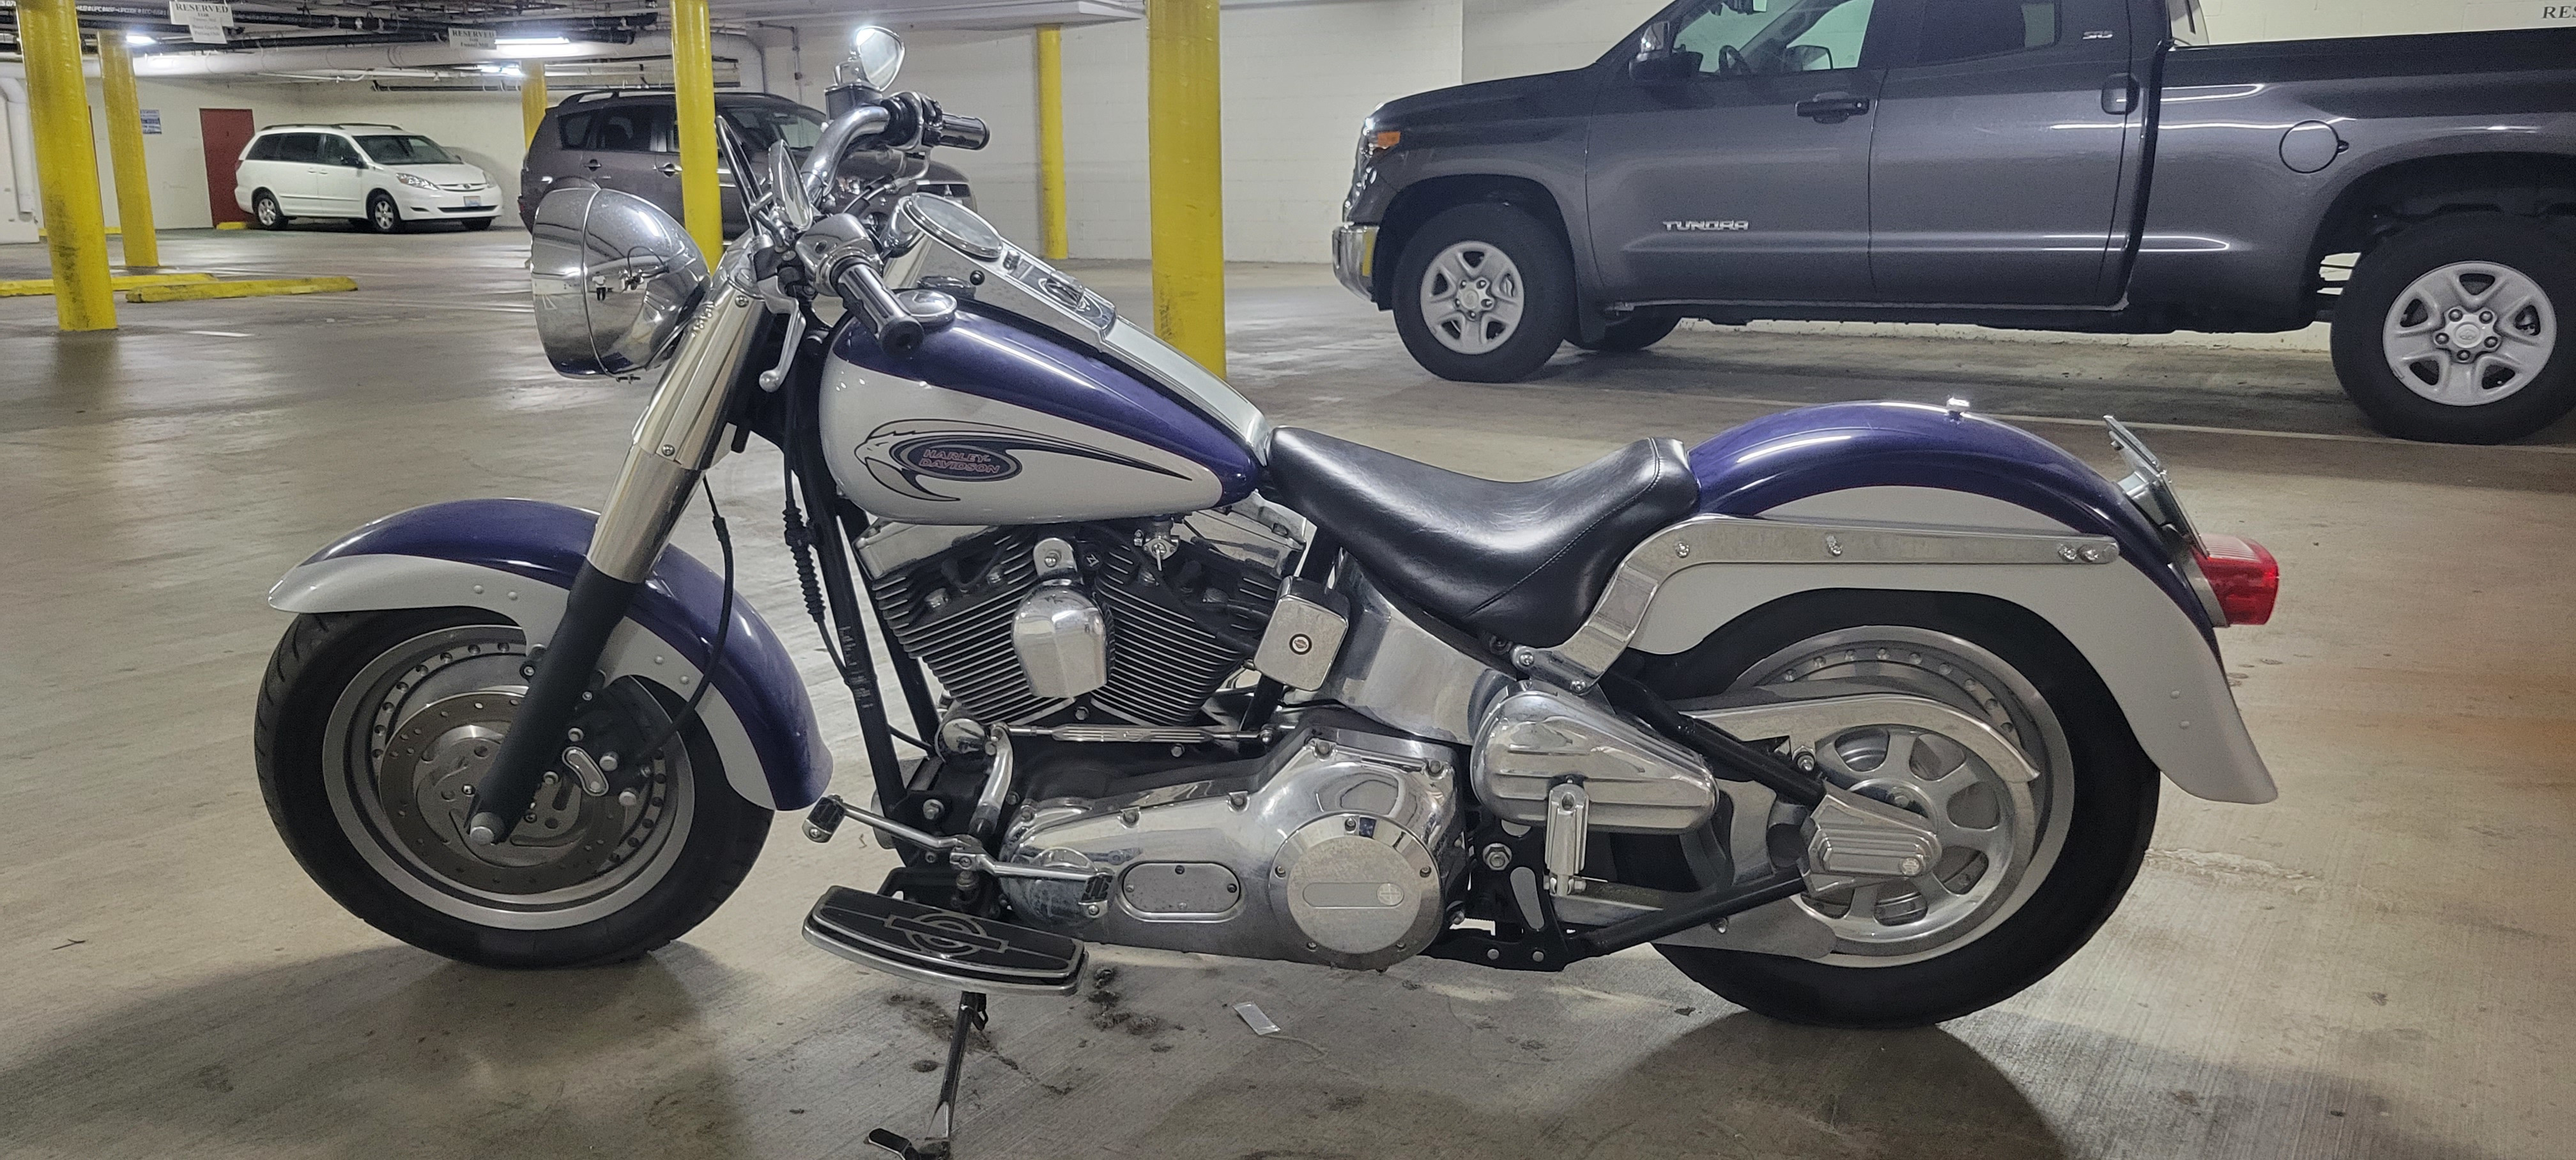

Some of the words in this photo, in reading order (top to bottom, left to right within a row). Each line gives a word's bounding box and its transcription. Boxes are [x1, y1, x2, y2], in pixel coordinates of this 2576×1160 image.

[176, 3, 229, 13] RESERVED
[452, 30, 494, 38] RESERVED
[1662, 220, 1749, 231] TUNDRA
[919, 458, 1000, 473] DAVIDSON
